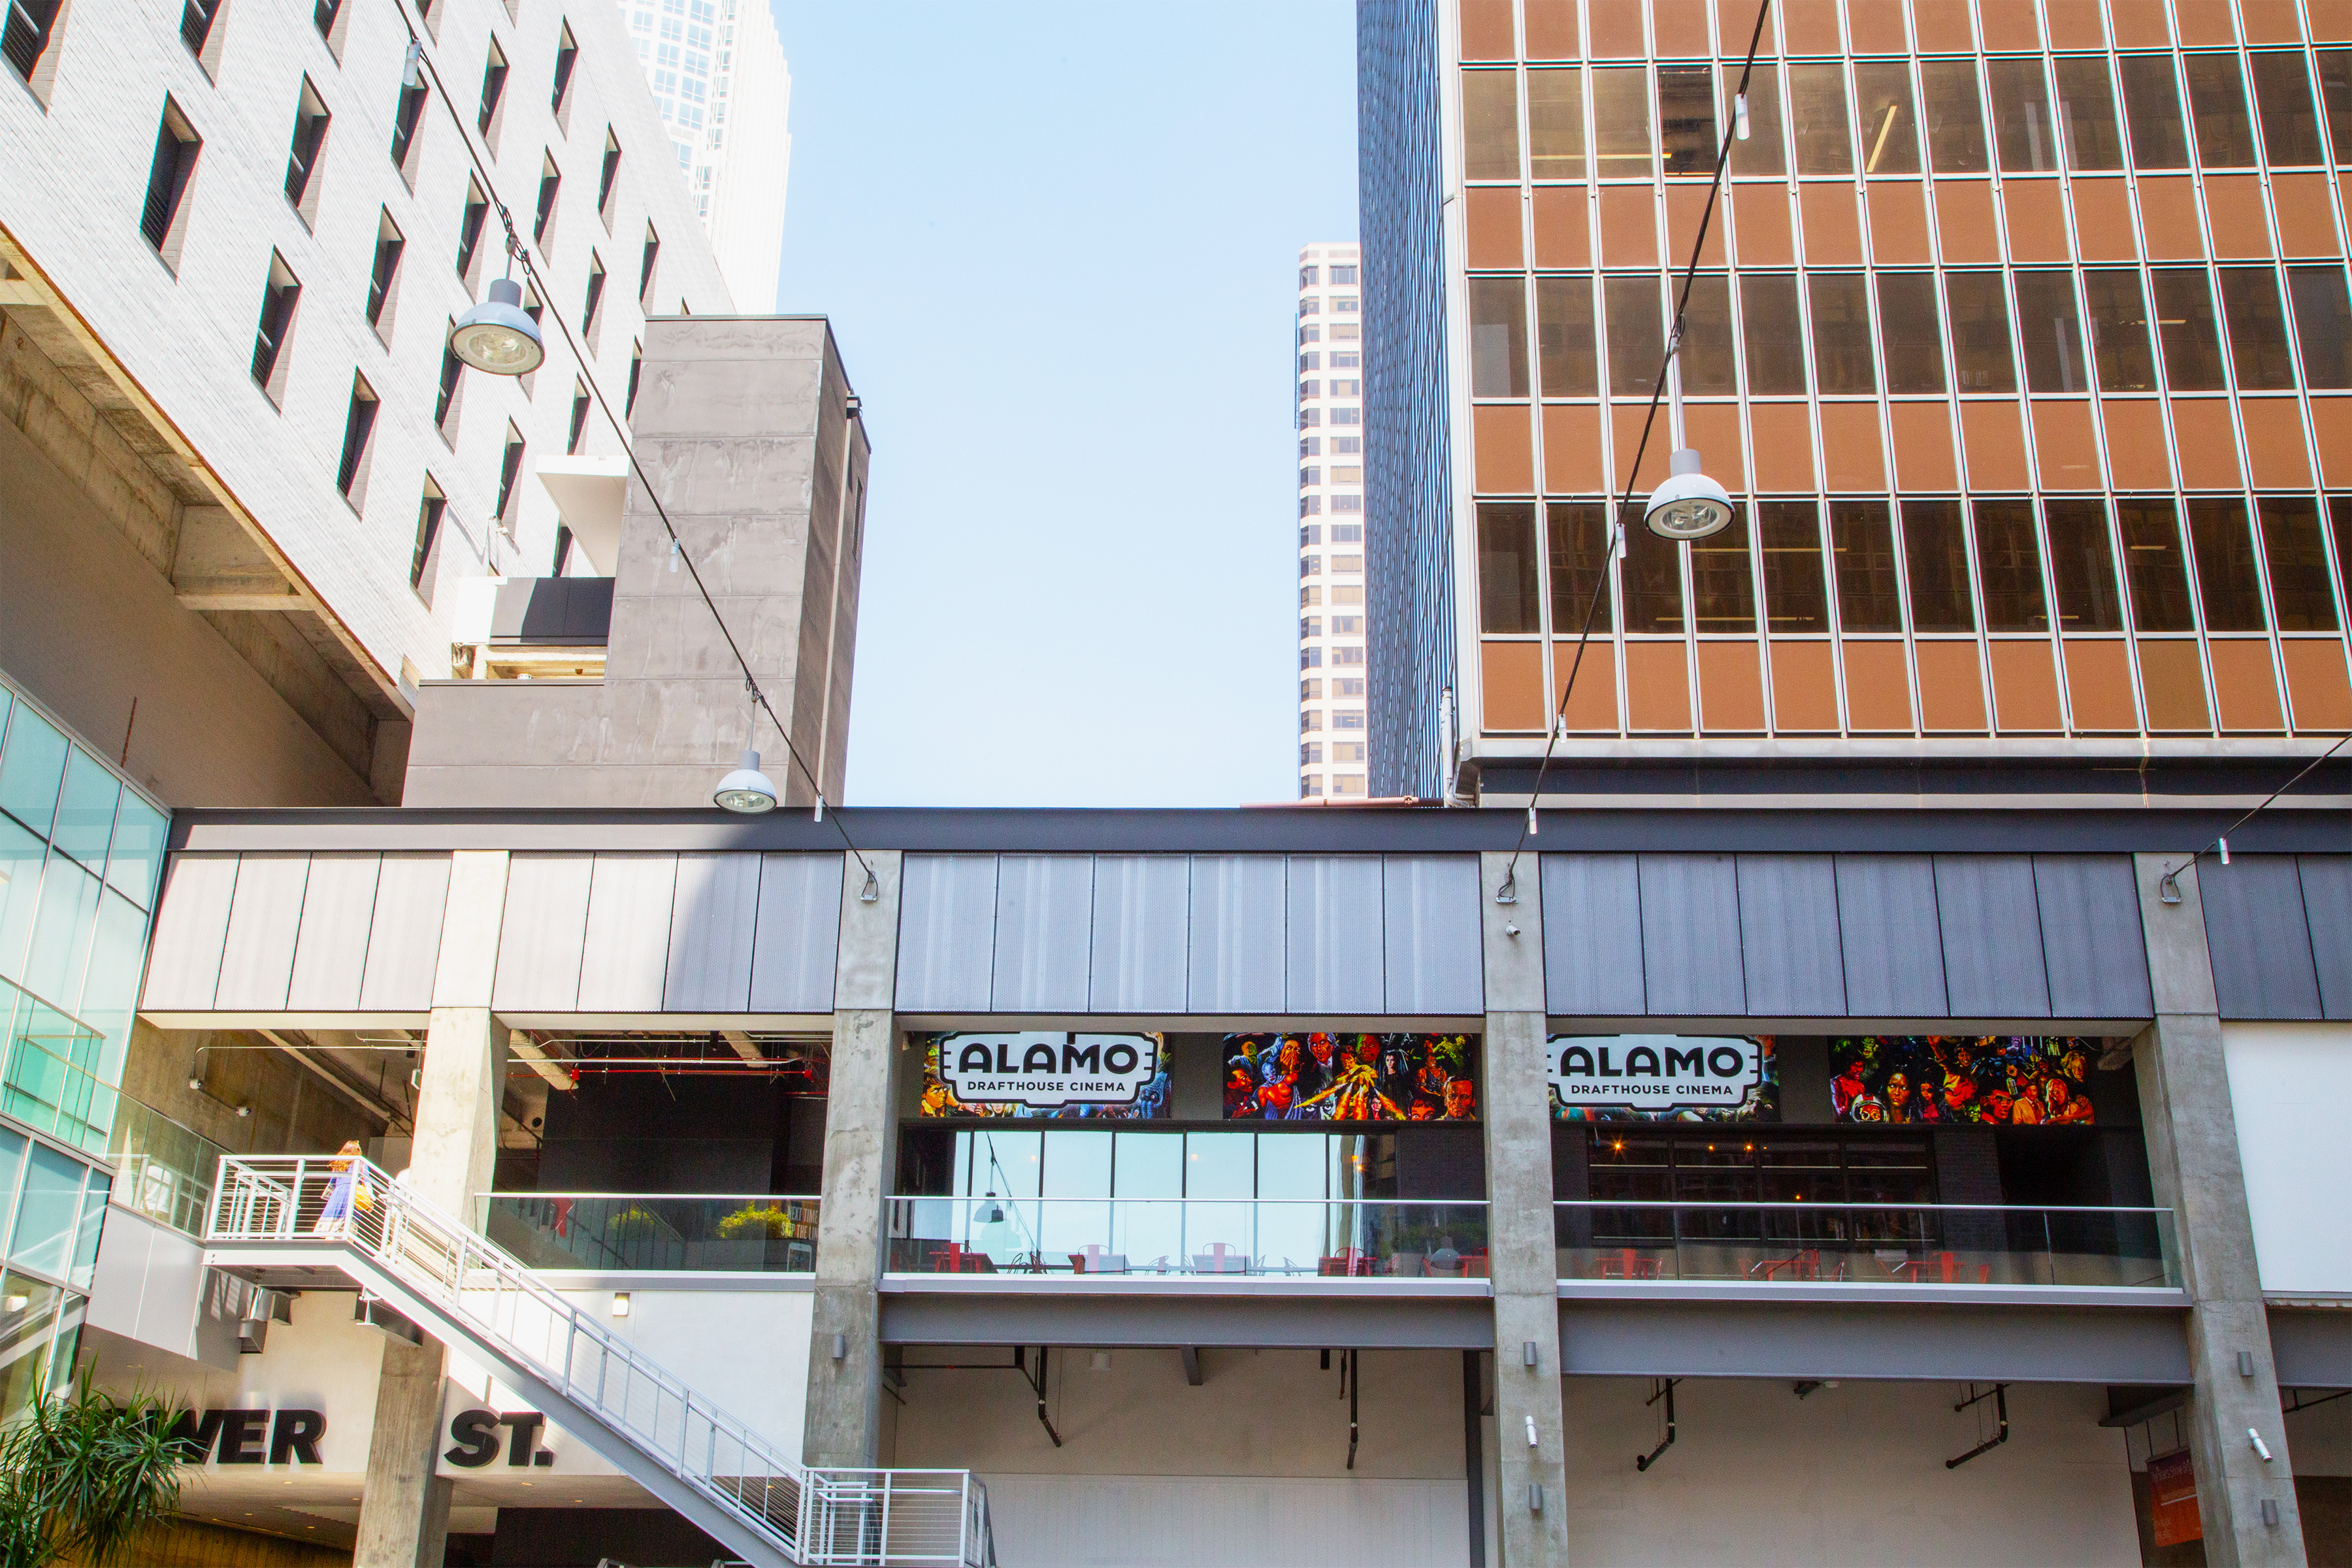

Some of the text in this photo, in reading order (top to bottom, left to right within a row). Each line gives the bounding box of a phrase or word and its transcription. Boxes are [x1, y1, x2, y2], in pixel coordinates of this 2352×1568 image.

[958, 1043, 1139, 1075] ALAMO
[1560, 1045, 1744, 1078] ALAMO
[968, 1081, 1126, 1092] DRAFTHOUSE CINEMA
[1571, 1085, 1733, 1095] DRAFTHOUSE CINEMA
[787, 1205, 819, 1224] NEXT TIME
[796, 1224, 808, 1239] THE
[106, 1409, 553, 1468] WER ST.
